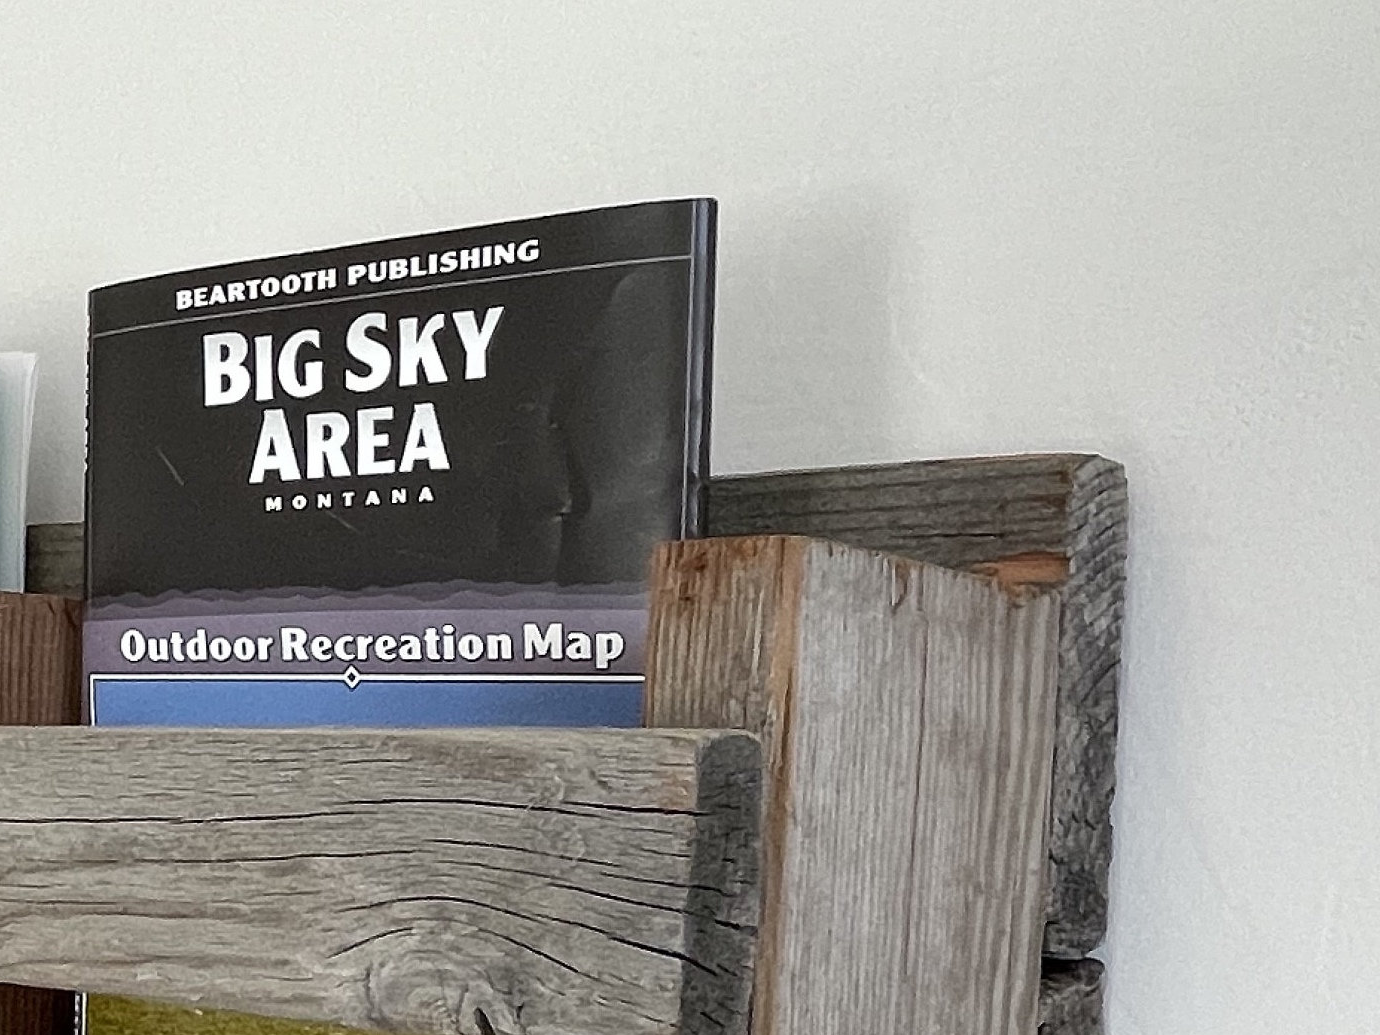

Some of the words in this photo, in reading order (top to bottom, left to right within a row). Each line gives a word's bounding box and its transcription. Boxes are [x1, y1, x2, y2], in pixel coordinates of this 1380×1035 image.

[175, 270, 338, 311] BEARTOOTH
[347, 239, 540, 287] PUBLISHING
[202, 328, 324, 408] BIG
[344, 305, 505, 394] SKY
[248, 402, 451, 485] AREA
[265, 486, 435, 512] MONTANA
[119, 626, 274, 664] Outdoor
[280, 623, 513, 664] Recreation
[523, 621, 625, 669] Map
